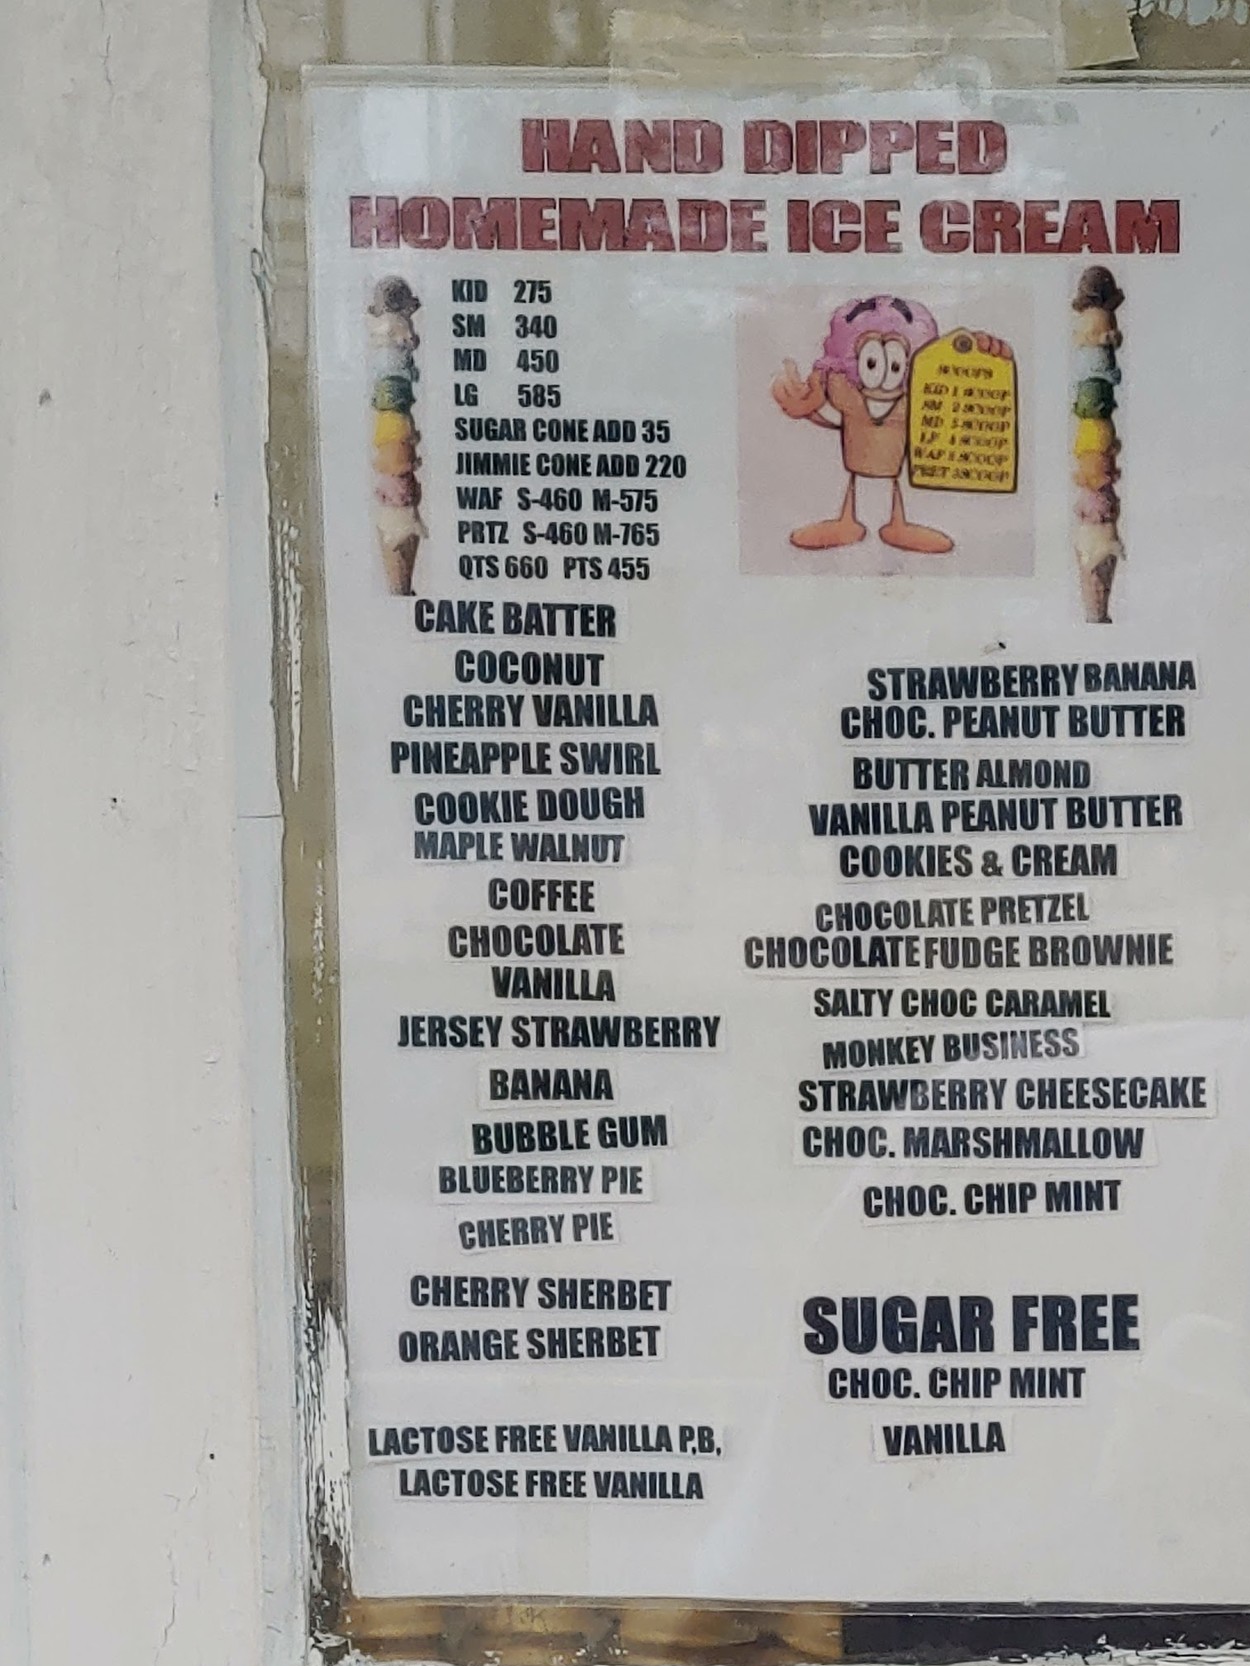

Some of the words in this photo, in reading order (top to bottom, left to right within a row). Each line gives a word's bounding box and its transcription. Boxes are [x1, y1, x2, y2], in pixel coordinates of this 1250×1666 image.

[521, 118, 723, 174] HAND
[743, 120, 1008, 175] DIPPED
[349, 196, 768, 253] HOMEMADE
[787, 199, 902, 254] ICE
[919, 199, 1180, 254] CREAM
[452, 313, 485, 337] SM
[515, 314, 557, 339] 340
[454, 383, 478, 406] LG
[518, 384, 561, 408] 585
[456, 452, 531, 476] JIMMIE
[536, 453, 592, 477] CONE
[596, 454, 639, 477] ADD
[646, 454, 686, 478] 220
[459, 555, 499, 580] QTS
[505, 555, 548, 579] 660
[564, 557, 603, 580] PTS
[608, 557, 650, 580] 455
[868, 664, 1079, 701] STRAWBERRY
[1084, 661, 1196, 692] BANANA
[391, 741, 552, 775] PINEAPPLE
[559, 742, 661, 775] SWIRL
[853, 757, 969, 791] BUTTER
[976, 759, 1090, 789] ALMOND
[415, 830, 503, 861] MAPLE
[511, 832, 625, 863] WALNUT
[489, 878, 595, 912] COFFEE
[816, 898, 974, 933] CHOCOLATE
[981, 892, 1090, 926] PRETZEL
[744, 935, 920, 969] CHOCOLATE
[924, 936, 1020, 969] FUDGE
[1029, 933, 1173, 967] BROWNIE
[398, 1015, 503, 1048] JERSEY
[511, 1016, 720, 1048] STRAWBERRY
[799, 1078, 1007, 1112] STRAWBERRY
[1016, 1077, 1206, 1110] CHEESECAKE
[803, 1126, 895, 1158] CHOC.
[904, 1127, 1144, 1159] MARSHMALLOW
[458, 1214, 564, 1250] CHERRY
[572, 1212, 614, 1242] PIE
[803, 1296, 994, 1355] SUGAR
[1012, 1294, 1140, 1352] FREE
[399, 1329, 519, 1362] ORANGE
[526, 1326, 661, 1359] SHERBET
[883, 1422, 1006, 1456] VANILLA
[400, 1469, 518, 1497] LACTOSE
[526, 1470, 587, 1498] FREE
[593, 1471, 703, 1499] VANILLA
